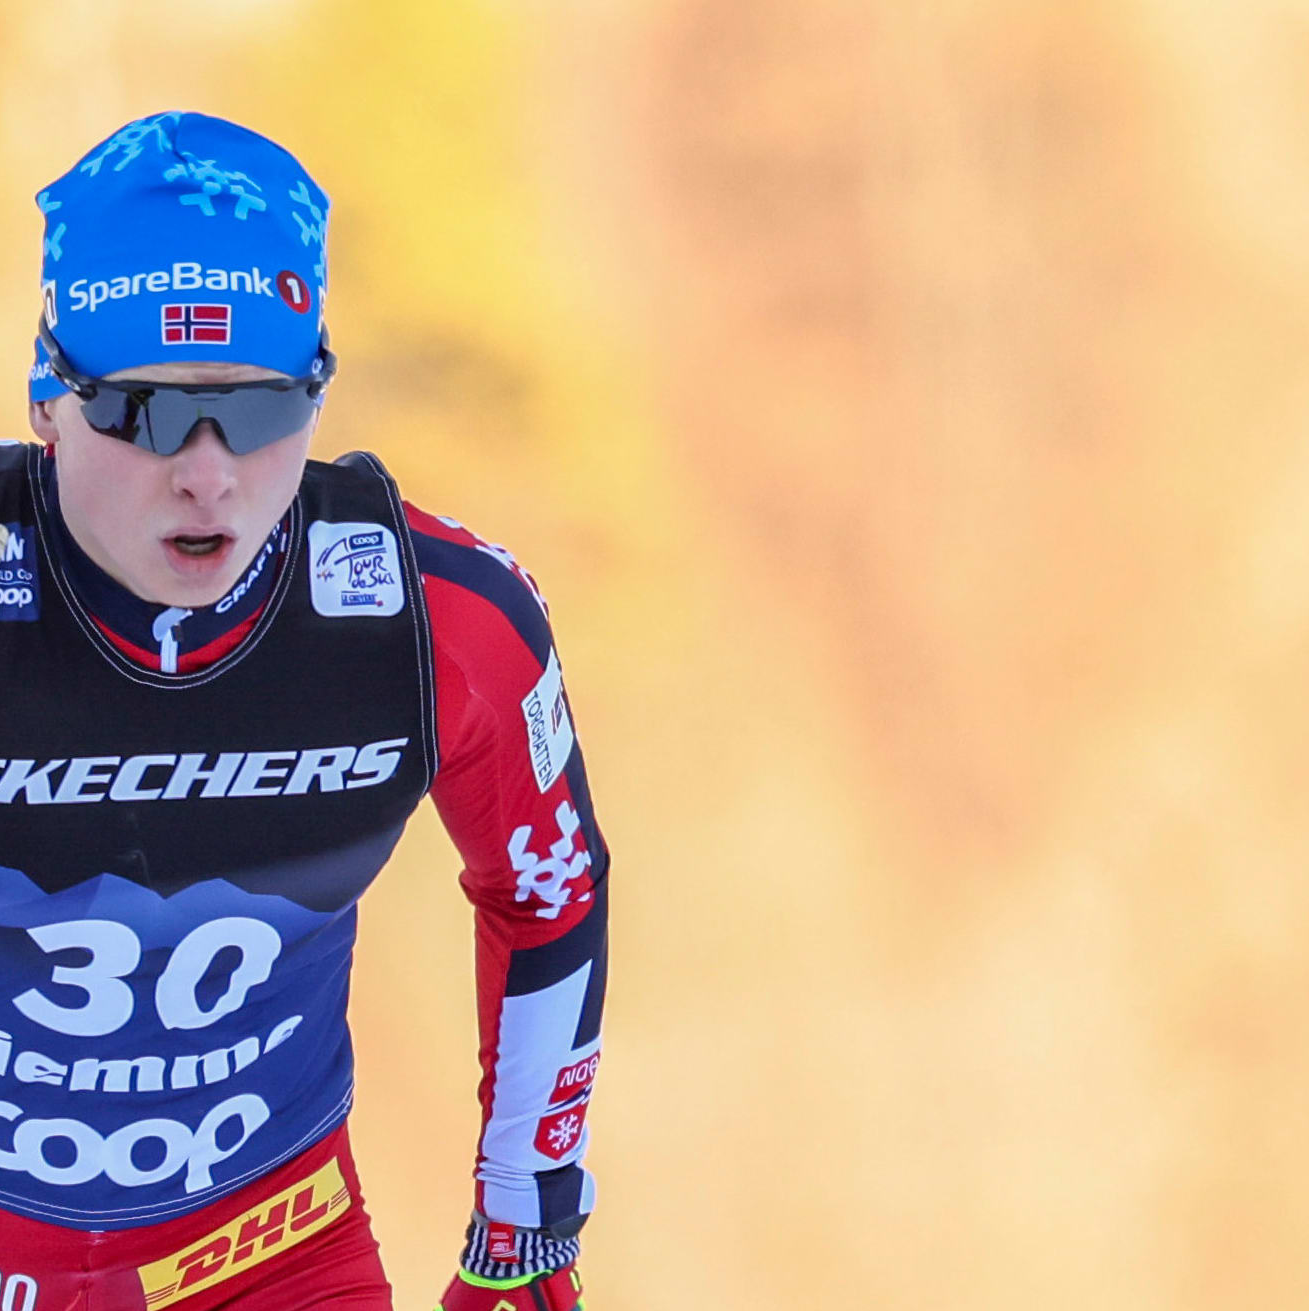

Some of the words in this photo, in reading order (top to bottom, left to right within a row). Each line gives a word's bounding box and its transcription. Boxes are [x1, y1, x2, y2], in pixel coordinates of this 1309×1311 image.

[69, 262, 275, 312] SpareBank
[524, 690, 555, 788] TORGHATTEN
[12, 916, 282, 1038] 30
[176, 1183, 332, 1292] DHL
